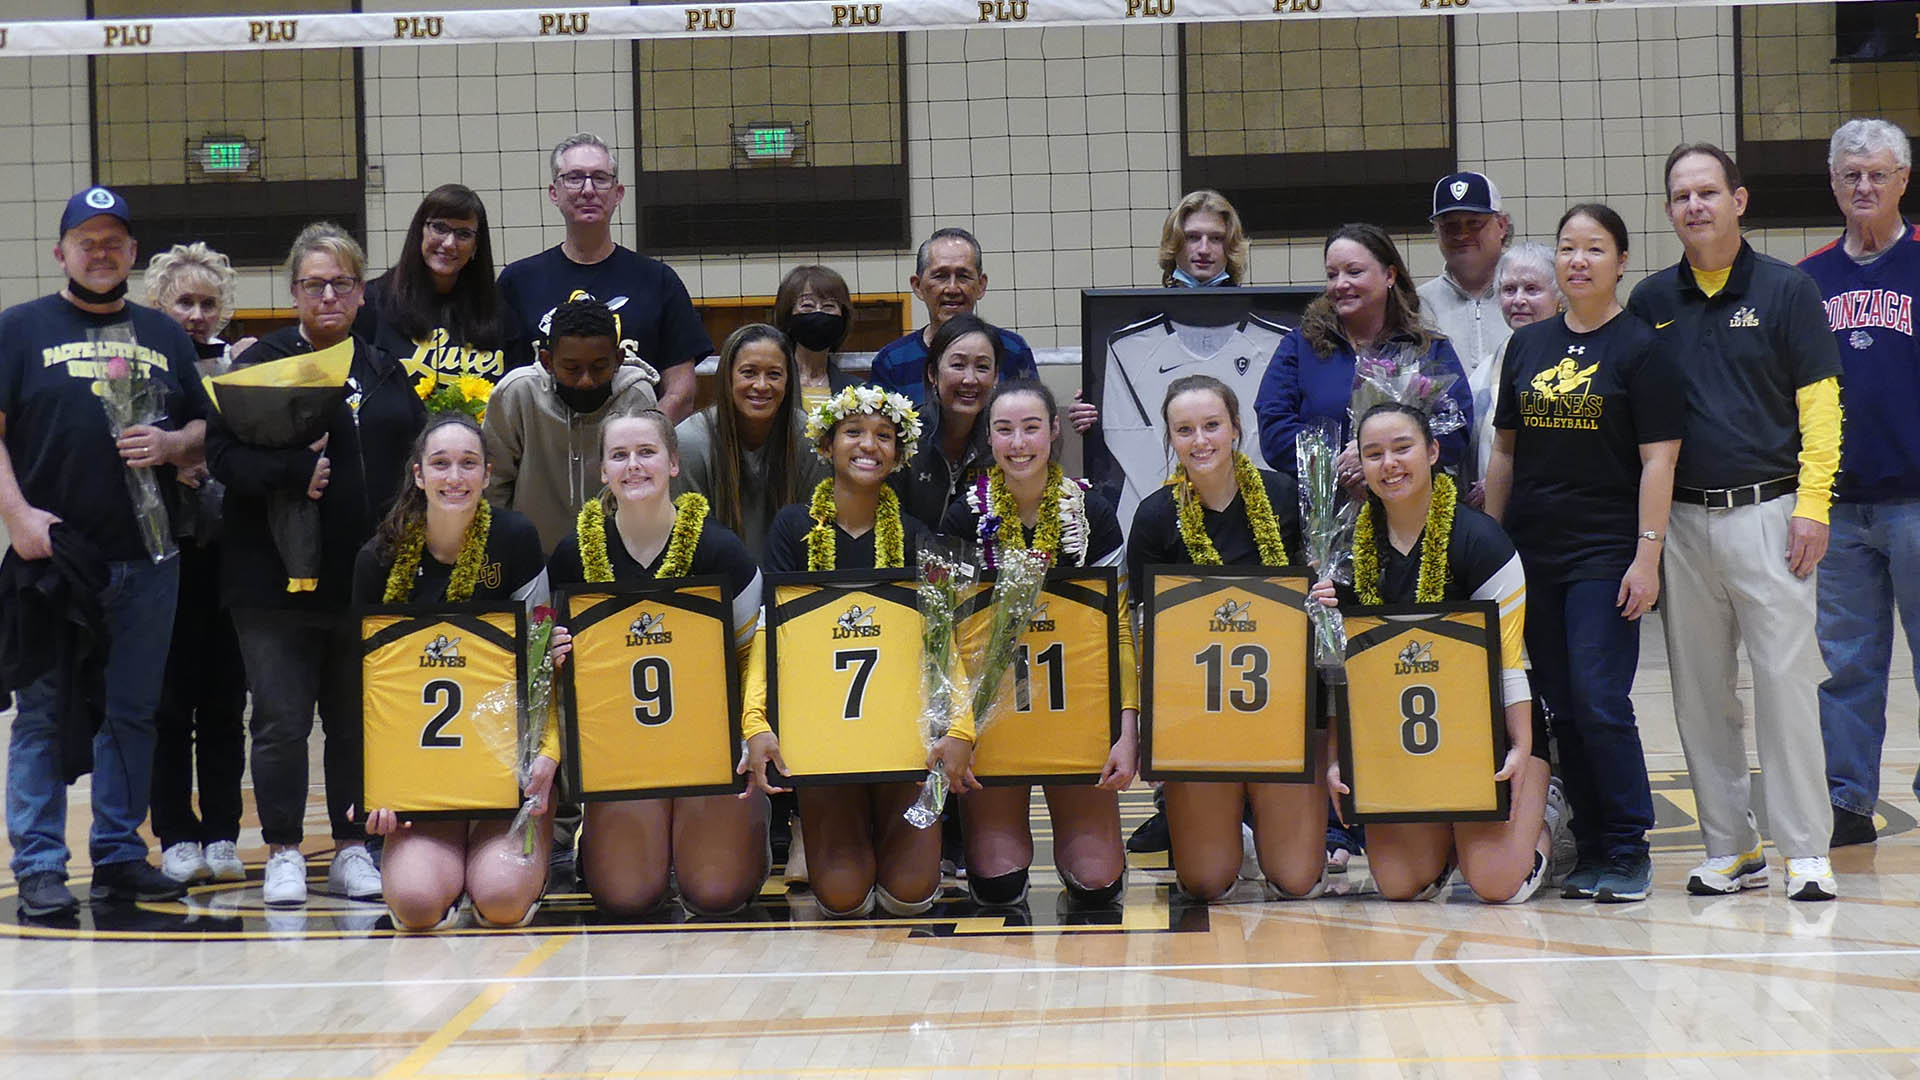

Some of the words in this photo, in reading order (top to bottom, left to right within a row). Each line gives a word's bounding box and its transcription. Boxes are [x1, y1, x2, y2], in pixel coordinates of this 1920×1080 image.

[685, 8, 735, 31] PLU
[832, 4, 881, 26] PLU
[978, 0, 1027, 22] PLU
[1126, 0, 1174, 17] PLU
[104, 24, 152, 46] PLU
[249, 20, 297, 42] PLU
[394, 16, 443, 38] PLU
[539, 13, 588, 35] PLU
[754, 129, 785, 154] EXIT
[210, 144, 240, 168] EXIT
[1729, 318, 1759, 327] LUTES
[1822, 289, 1912, 336] ONZAGA
[1520, 391, 1603, 418] LUTES
[1523, 416, 1599, 430] VOLLEYBALL
[832, 625, 881, 640] LUTES
[1208, 620, 1257, 632] LUTES
[626, 631, 673, 647] LUTES
[419, 655, 466, 668] LUTES
[1394, 660, 1440, 675] LUTES
[833, 647, 880, 720] 7
[1012, 641, 1065, 713] 11
[1193, 642, 1271, 714] 13
[630, 655, 675, 727] 9
[420, 679, 463, 750] 2
[1399, 684, 1440, 756] 8
